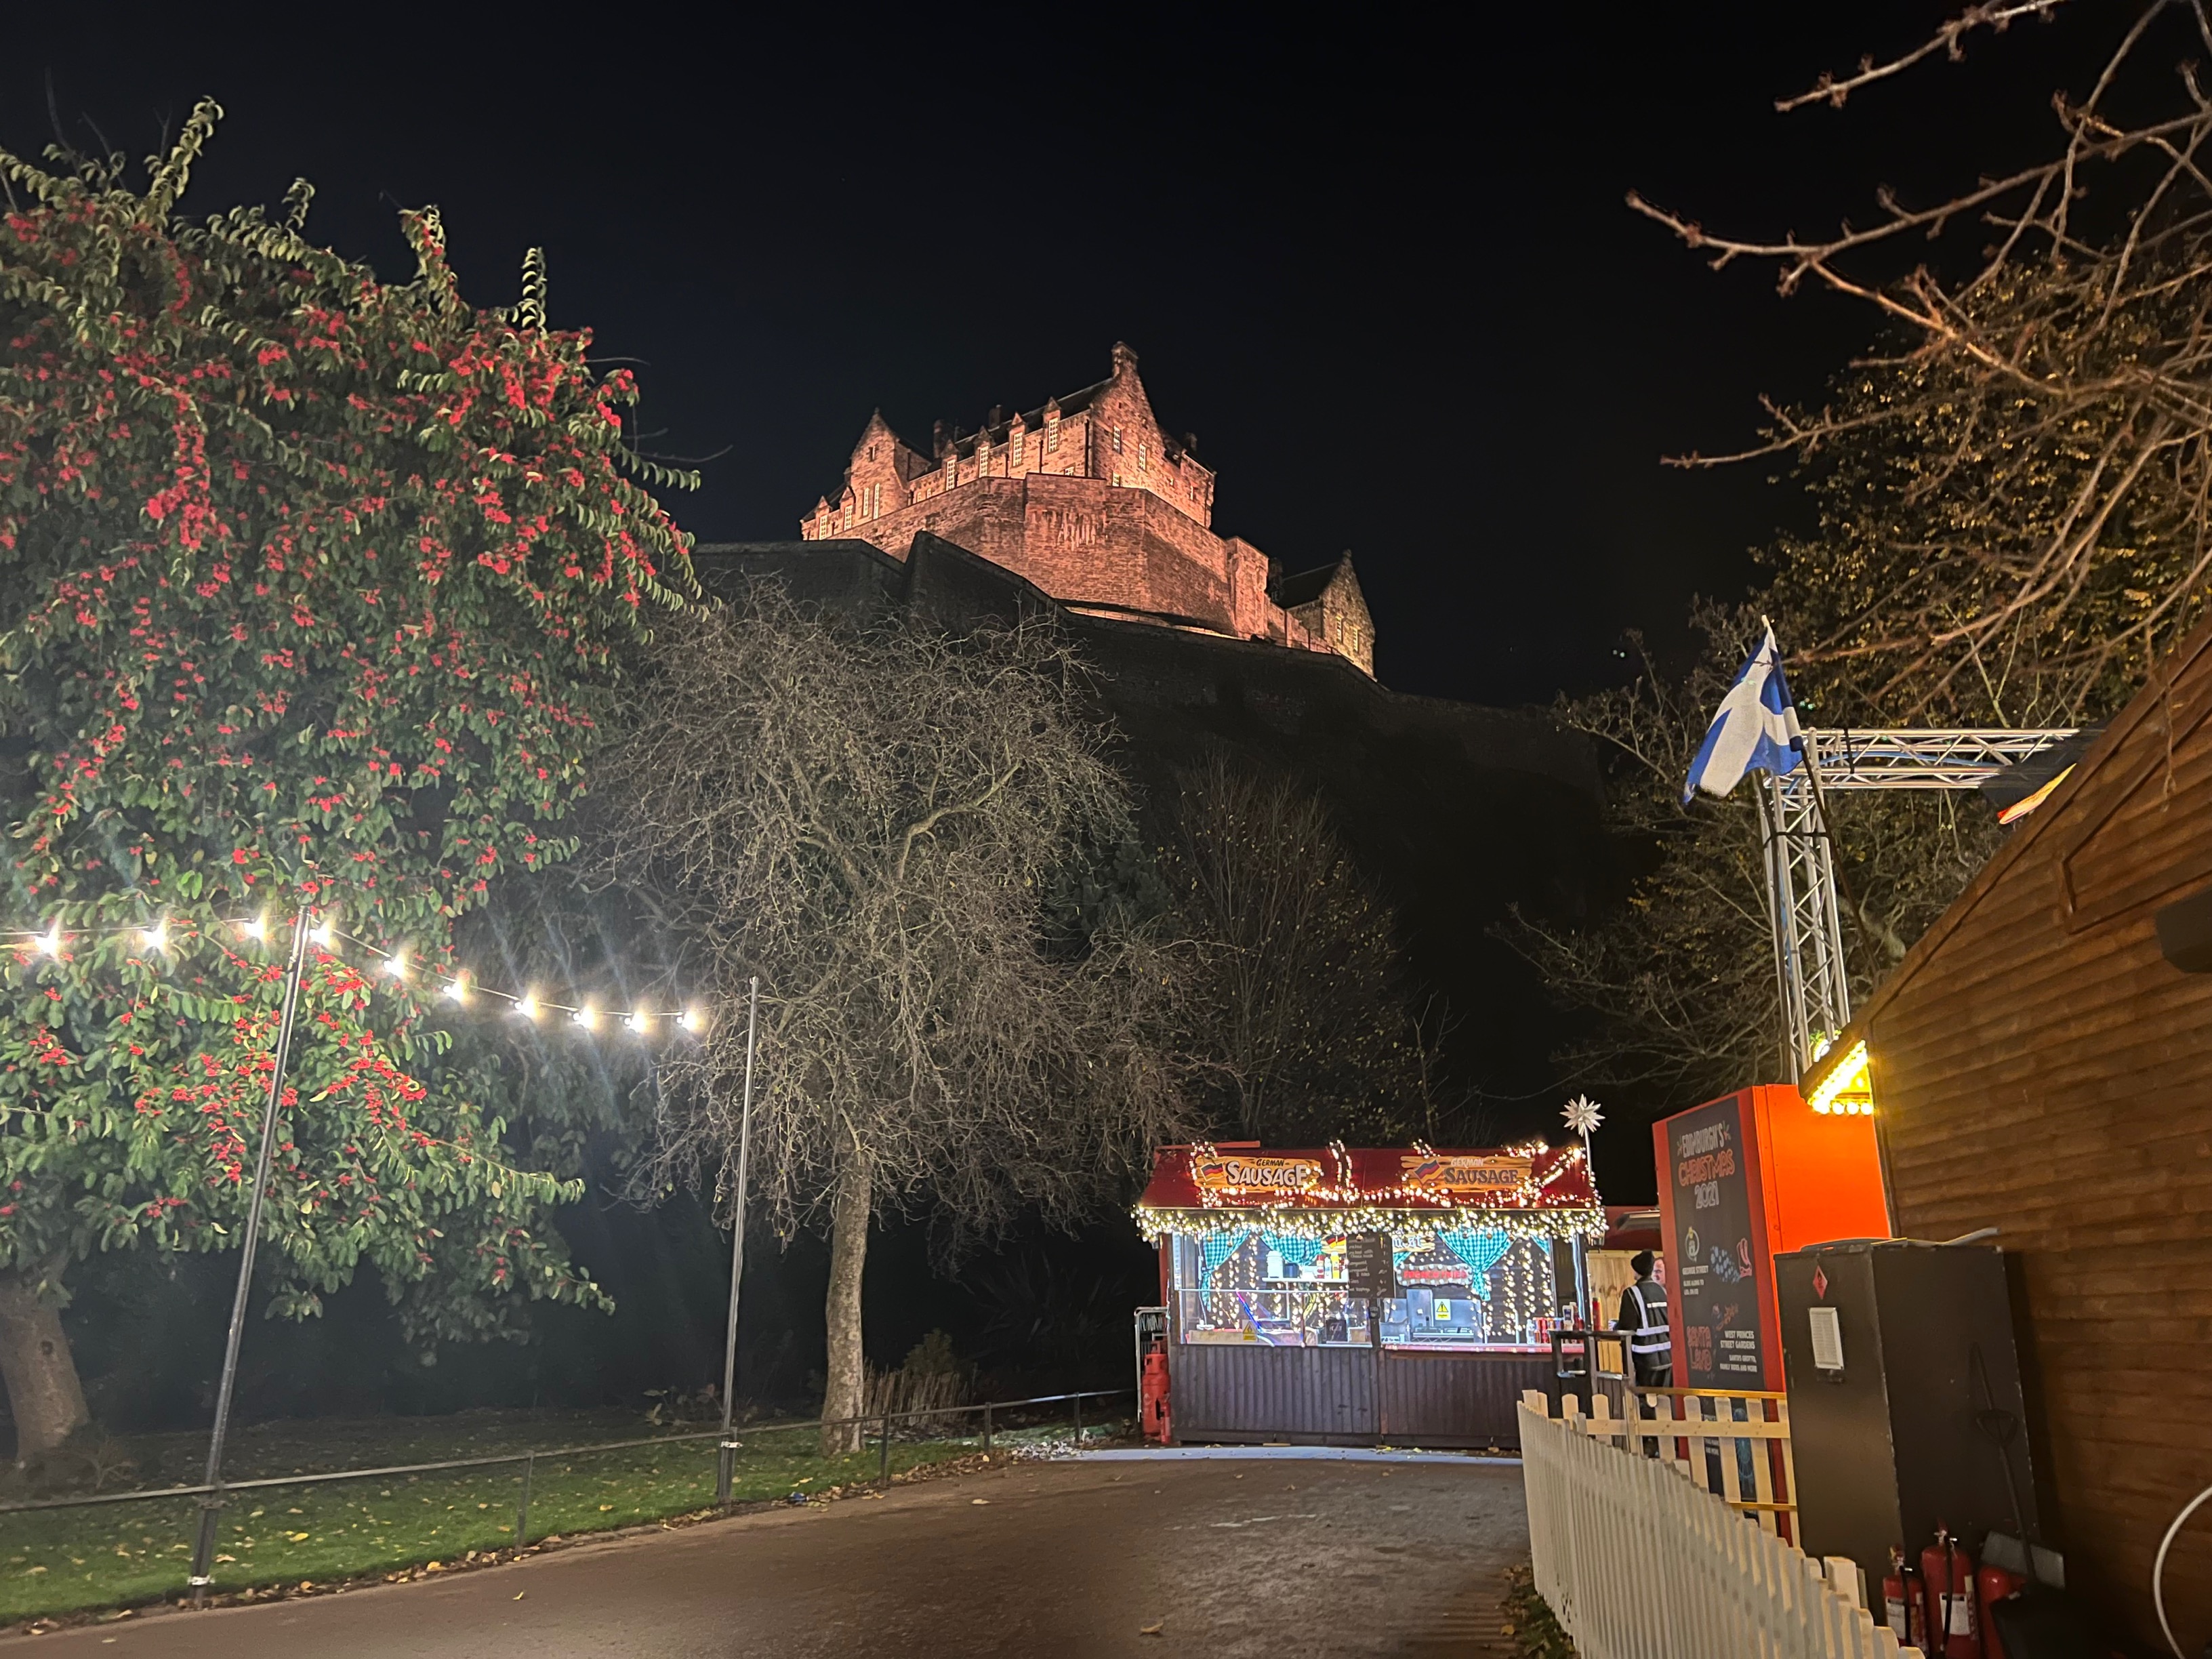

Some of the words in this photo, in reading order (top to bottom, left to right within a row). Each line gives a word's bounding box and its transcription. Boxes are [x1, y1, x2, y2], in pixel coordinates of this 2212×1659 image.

[1681, 1122, 1725, 1158] EDINBURGH'S
[1226, 1160, 1309, 1187] SAUSAGE
[1256, 1158, 1285, 1166] GERMAN
[1450, 1158, 1484, 1168] GERMAN
[1678, 1148, 1736, 1187] CHRISTMAS
[1443, 1167, 1519, 1185] SAUSAGE
[1694, 1181, 1719, 1209] 2021
[1686, 1325, 1712, 1348] SANTA
[1720, 1340, 1735, 1349] STREET
[1735, 1340, 1756, 1349] GARDENS
[1736, 1330, 1755, 1339] PRINCES
[1689, 1347, 1713, 1372] LAND
